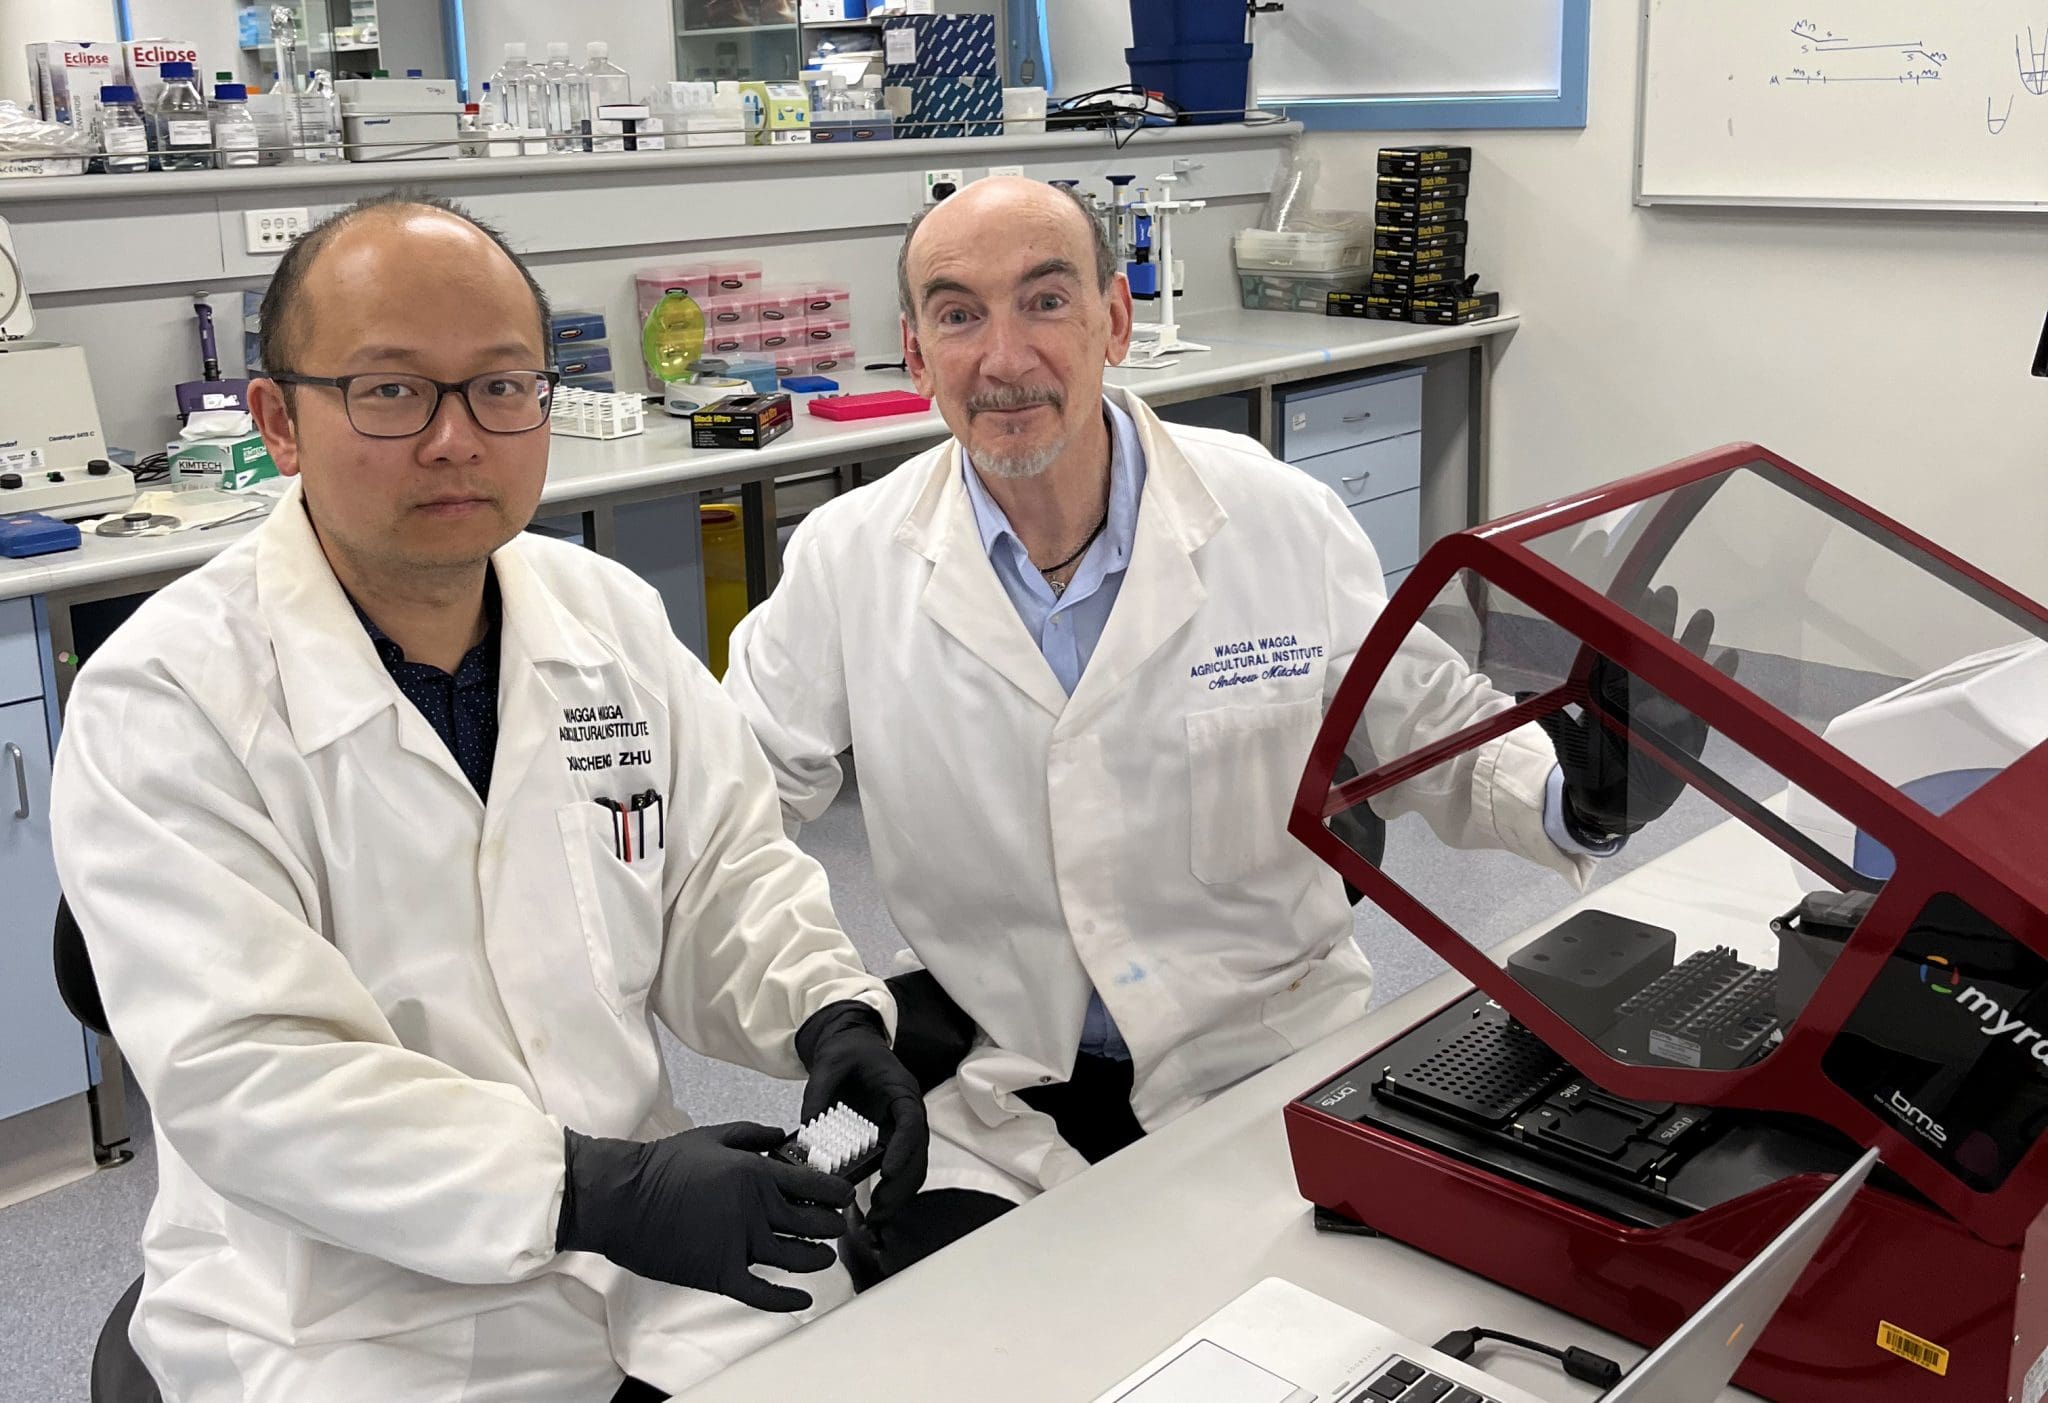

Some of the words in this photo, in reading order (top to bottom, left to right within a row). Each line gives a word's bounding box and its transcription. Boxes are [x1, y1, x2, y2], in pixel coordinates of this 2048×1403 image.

[64, 52, 109, 69] Eclipse
[133, 46, 197, 63] Eclipse
[178, 461, 222, 471] KIMTECH
[1214, 640, 1255, 658] WAGGA
[1257, 634, 1298, 650] WAGGA
[1190, 654, 1269, 678] AGRICULTURAL
[1272, 646, 1324, 663] INSTITUTE
[1208, 673, 1259, 690] Andrew
[1261, 662, 1311, 680] Mitchell
[563, 706, 597, 724] WAGGA
[597, 705, 624, 722] WGGA
[619, 749, 652, 767] ZHU
[1321, 1086, 1358, 1107] bms
[1890, 1089, 1948, 1143] bms
